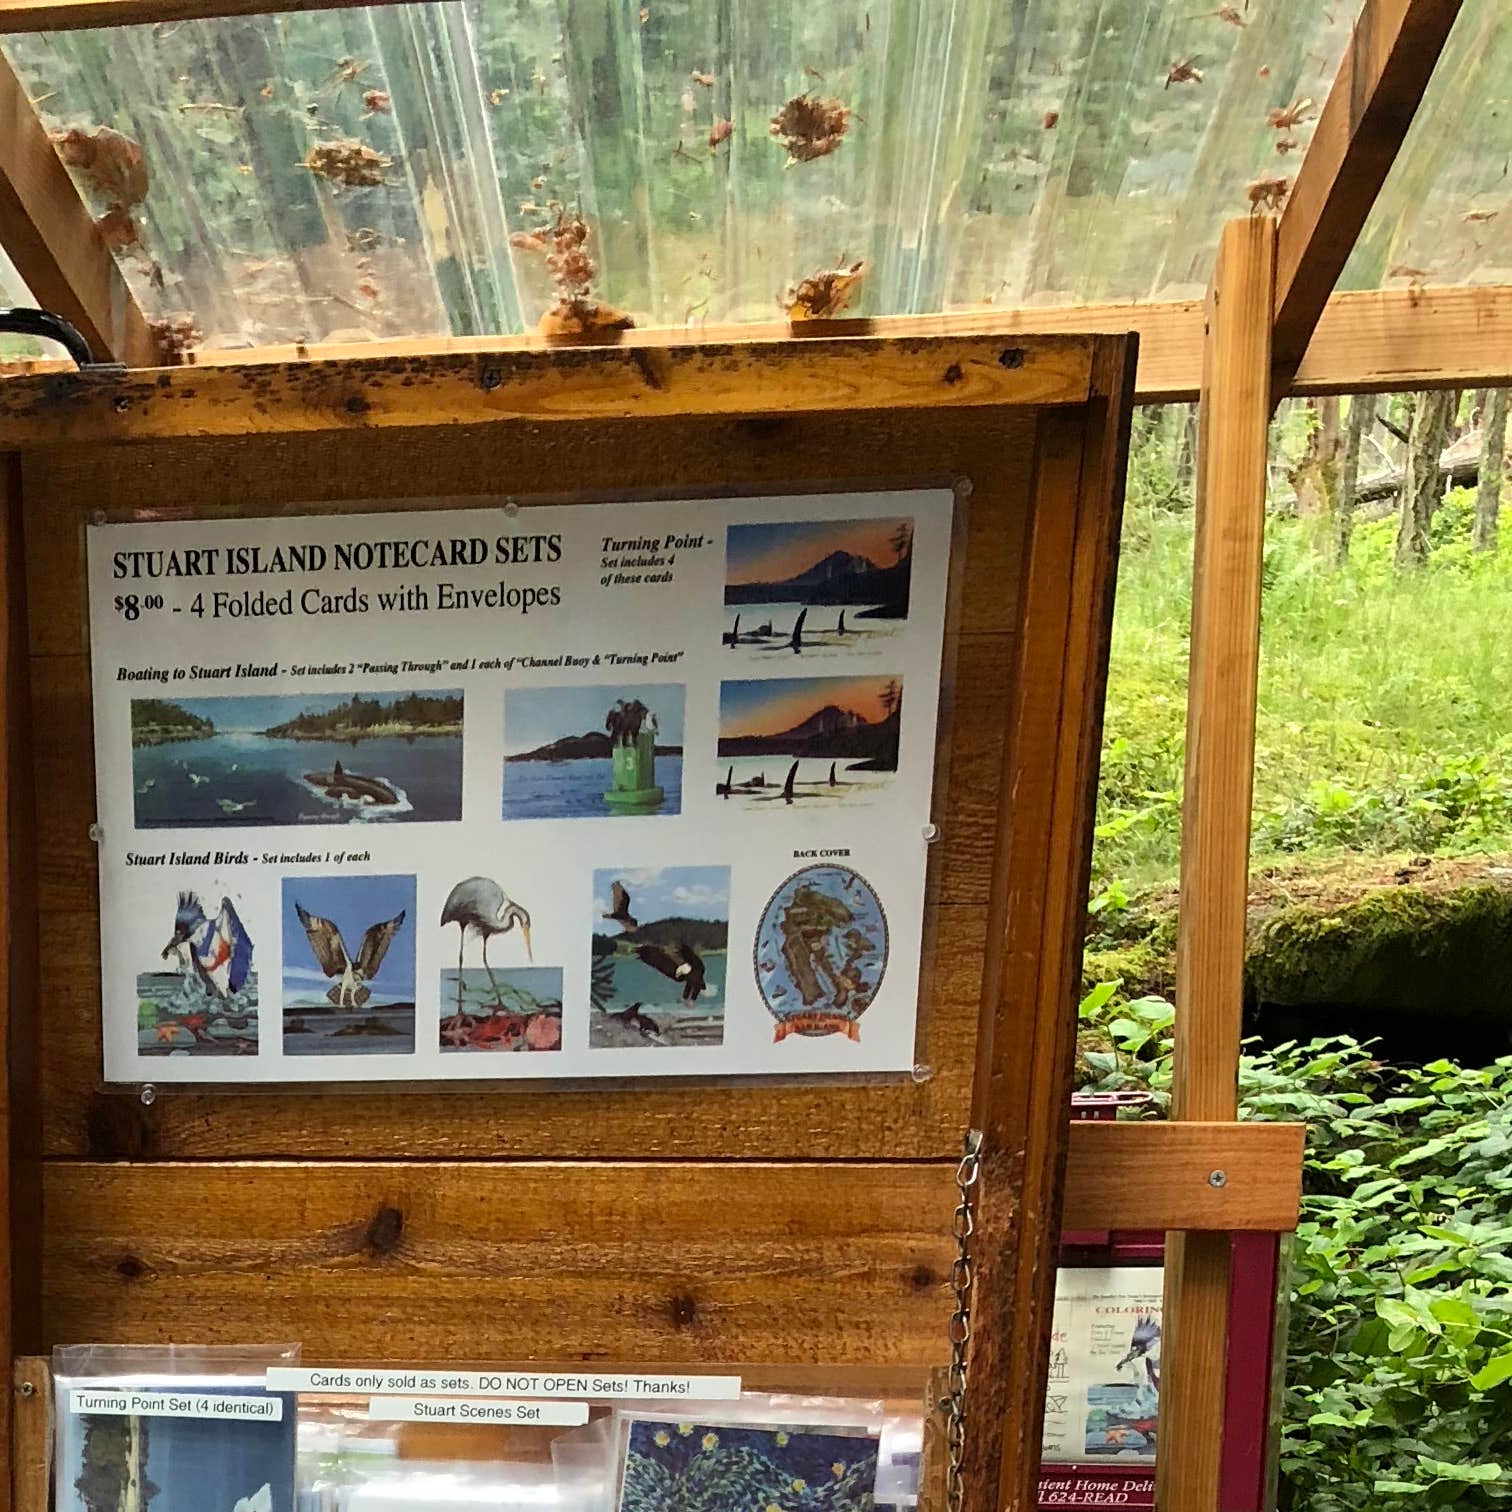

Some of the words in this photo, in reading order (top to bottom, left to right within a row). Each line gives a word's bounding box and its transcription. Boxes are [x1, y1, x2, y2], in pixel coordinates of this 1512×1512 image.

[601, 536, 661, 555] Turning
[663, 533, 704, 549] Point
[113, 549, 220, 578] STUART
[225, 545, 327, 575] ISLAND
[333, 539, 489, 570] NOTECARD
[494, 534, 562, 564] SETS
[600, 556, 619, 569] Set
[619, 554, 666, 568] includes
[667, 553, 676, 566] 4
[600, 573, 614, 588] of
[613, 572, 643, 584] these
[643, 570, 674, 584] cards
[190, 593, 205, 620] 4
[212, 589, 294, 618] Folded
[300, 586, 369, 615] Cards
[377, 584, 429, 612] with
[436, 580, 561, 616] Envelopes
[116, 666, 170, 684] Boating
[172, 667, 186, 680] to
[188, 664, 232, 680] Stuart
[234, 662, 279, 678] Island
[290, 664, 307, 676] Set
[307, 663, 347, 676] includes
[348, 662, 355, 675] 2
[449, 659, 470, 672] and
[470, 657, 477, 670] 1
[478, 657, 502, 670] each
[503, 656, 517, 671] of
[563, 655, 591, 670] Buoy
[591, 654, 601, 666] &
[125, 852, 166, 867] Stuart
[168, 850, 211, 866] Island
[213, 850, 249, 865] Birds
[261, 853, 279, 865] Set
[279, 852, 322, 864] includes
[325, 851, 331, 863] 1
[333, 850, 346, 865] of
[346, 850, 371, 862] each
[792, 850, 818, 859] BACK
[819, 848, 851, 858] COVER
[310, 1373, 352, 1389] Cards
[355, 1374, 384, 1390] only
[387, 1374, 416, 1389] sold
[419, 1378, 437, 1389] as
[440, 1377, 474, 1390] sets.
[478, 1376, 502, 1391] DO
[505, 1377, 540, 1392] NOT
[543, 1377, 588, 1393] OPEN
[591, 1378, 629, 1393] Sets!
[632, 1379, 691, 1394] Thanks!
[76, 1395, 127, 1412] Turning
[131, 1396, 165, 1413] Point
[168, 1398, 192, 1414] Set
[195, 1398, 209, 1413] (4
[212, 1400, 274, 1416] identical)
[413, 1403, 456, 1417] Stuart
[459, 1403, 512, 1418] Scenes
[516, 1405, 541, 1420] Set
[1074, 1479, 1119, 1492] Home
[1047, 1490, 1129, 1504] 624-READ
